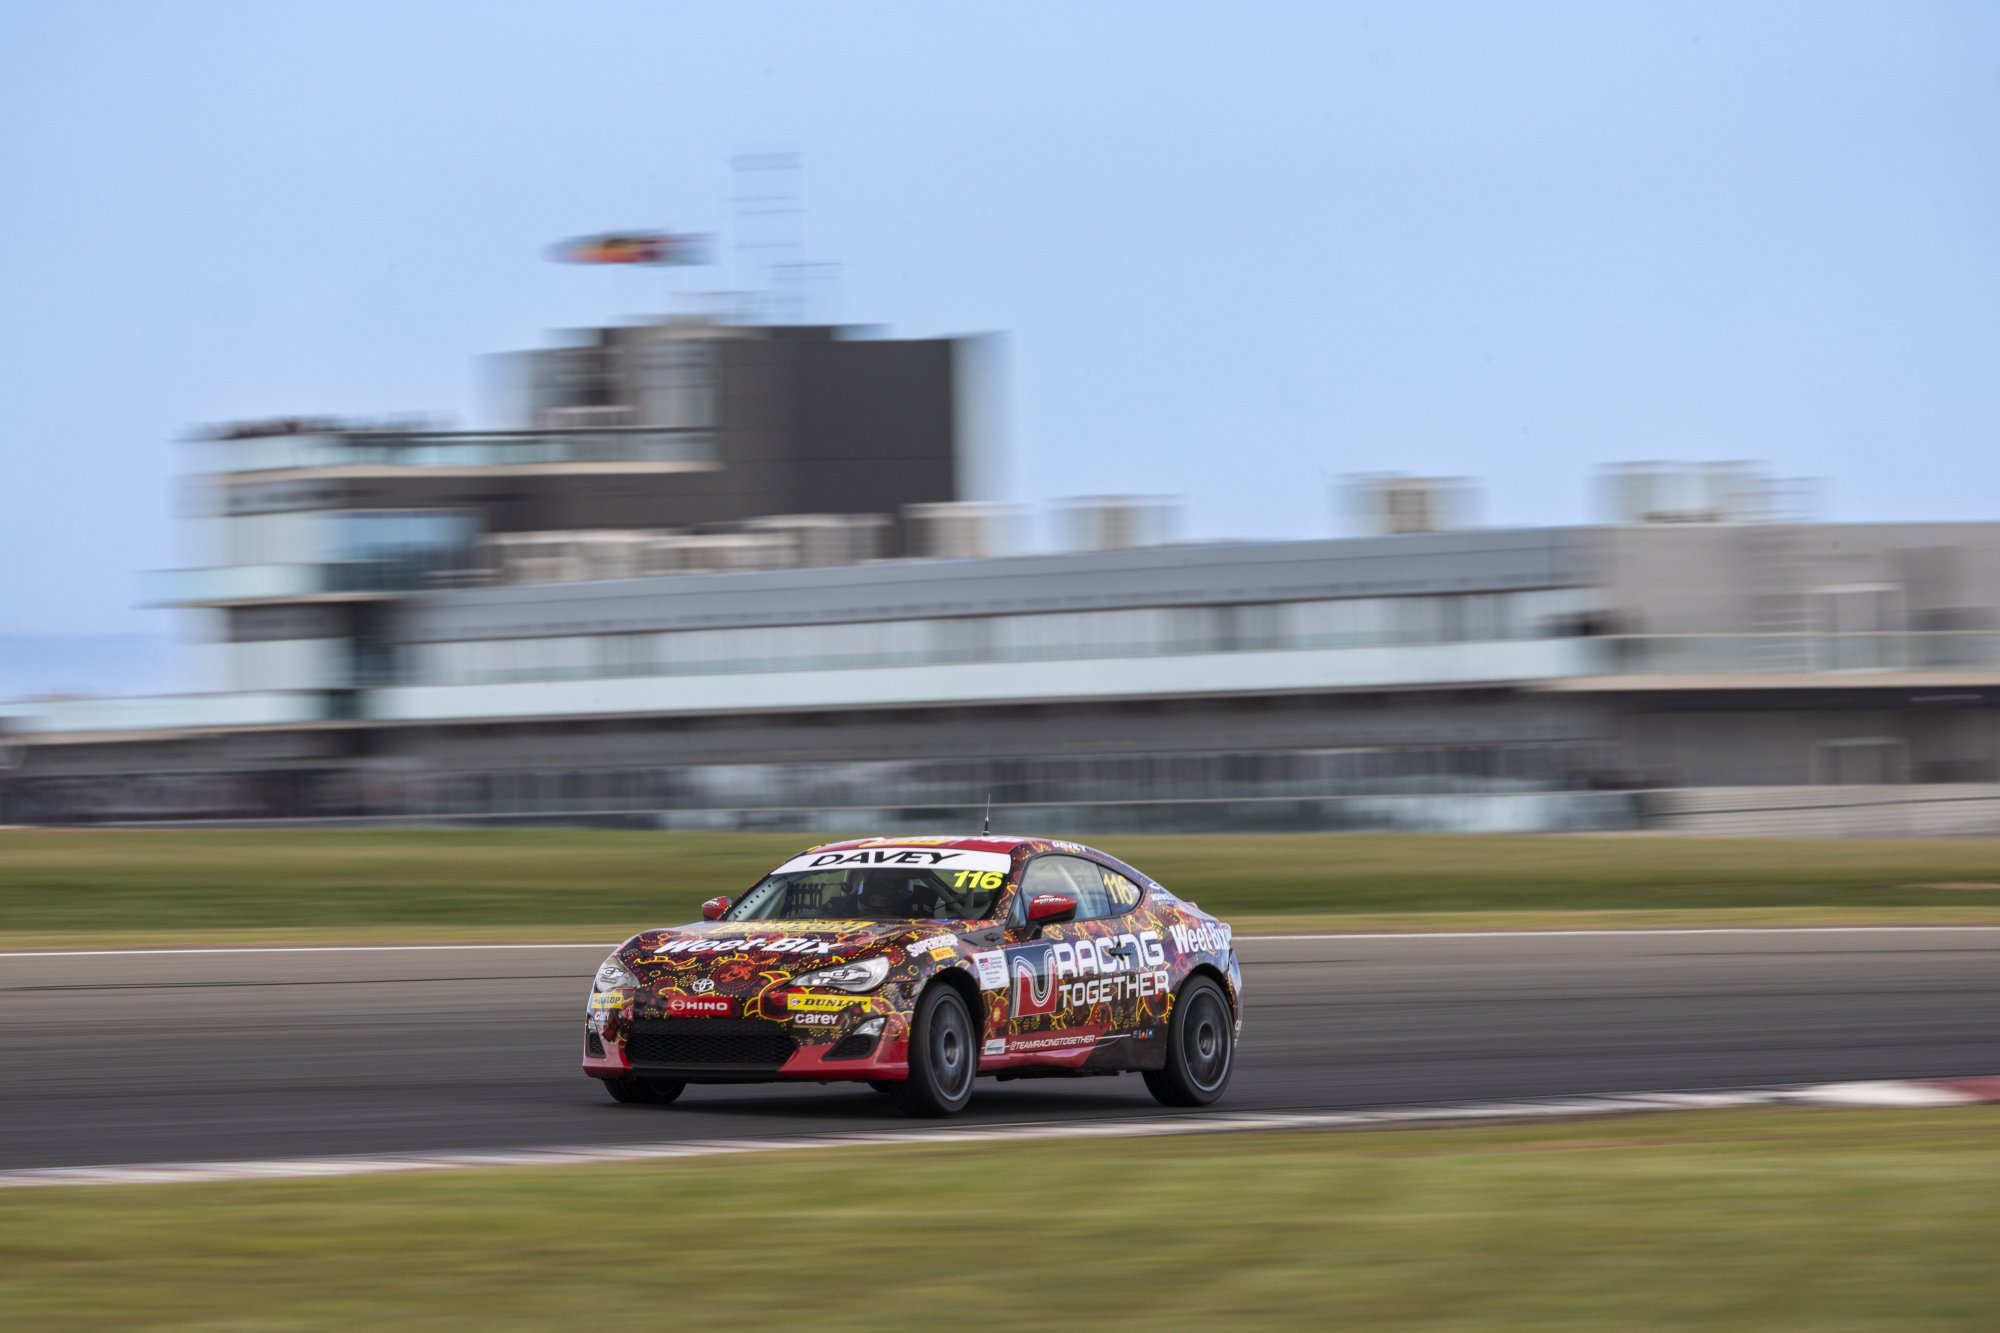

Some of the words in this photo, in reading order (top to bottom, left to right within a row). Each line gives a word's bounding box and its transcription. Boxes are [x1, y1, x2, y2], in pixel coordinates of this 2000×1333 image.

[809, 851, 964, 867] DAVEY
[953, 871, 1003, 889] 116
[1103, 873, 1133, 905] 116
[654, 937, 843, 954] Weet-Bix
[1169, 921, 1229, 954] Weet-Bix
[1053, 931, 1164, 979] RACING
[1059, 970, 1170, 1008] TOGETHER
[686, 1001, 728, 1011] HINO
[803, 998, 868, 1008] DUNLOP
[795, 1013, 839, 1025] carey
[1010, 1034, 1095, 1050] @TEAMRACINGTOGETHER
